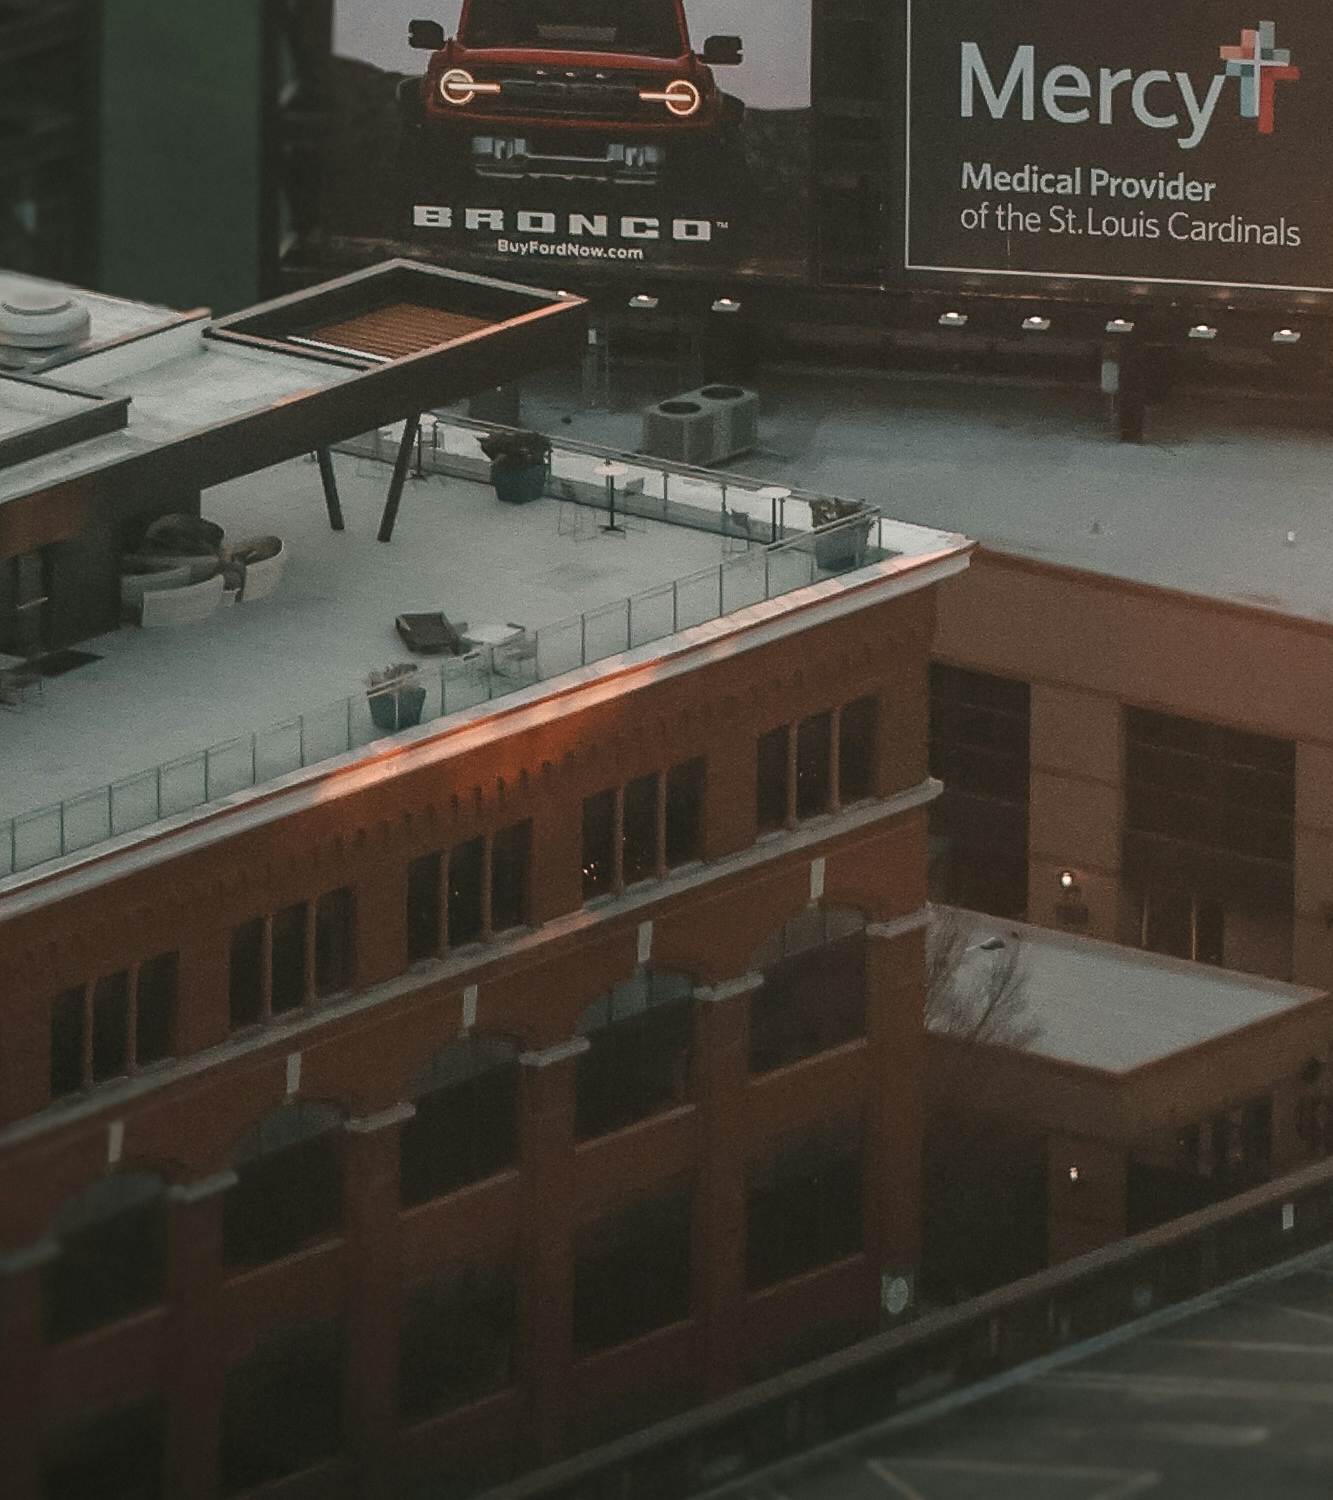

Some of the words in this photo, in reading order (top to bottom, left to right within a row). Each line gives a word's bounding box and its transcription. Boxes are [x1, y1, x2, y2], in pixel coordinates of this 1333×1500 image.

[961, 41, 1226, 149] Mercy
[961, 162, 1082, 195] Medical
[1090, 168, 1217, 202] Provider
[961, 202, 989, 229] of
[996, 204, 1042, 233] the
[1168, 212, 1301, 247] Cardinals
[498, 239, 643, 260] BuyFordNow.com
